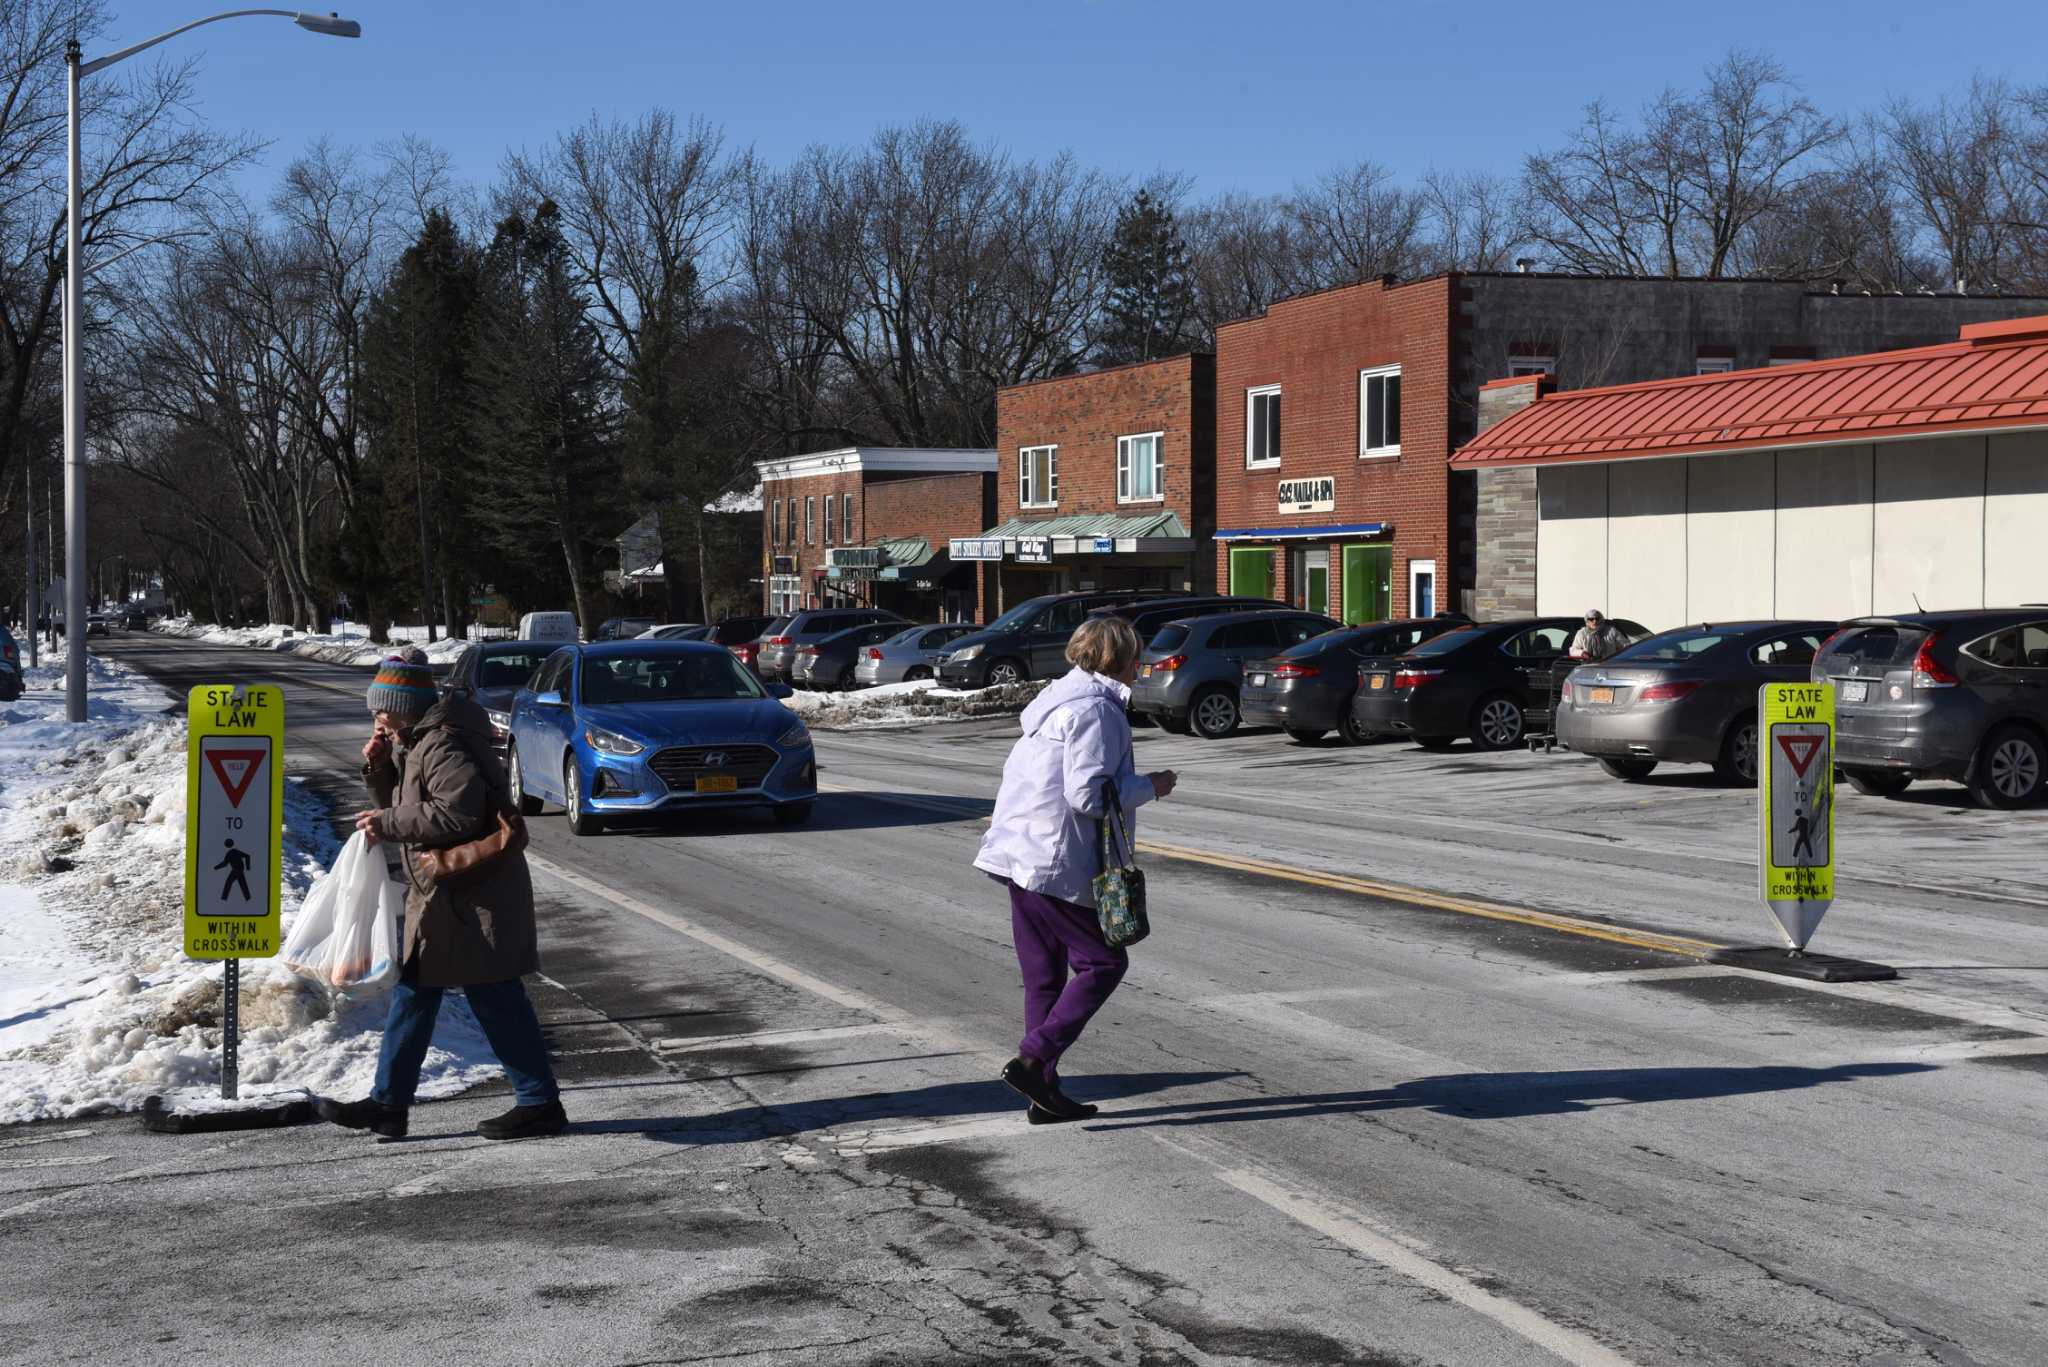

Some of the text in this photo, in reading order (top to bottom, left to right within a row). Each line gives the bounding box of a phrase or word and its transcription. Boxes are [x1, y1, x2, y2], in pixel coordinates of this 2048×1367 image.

[1293, 480, 1313, 503] NAILS
[1314, 480, 1320, 502] &
[1320, 479, 1334, 501] SPA
[206, 690, 268, 708] STATE
[1778, 689, 1823, 703] STATE
[1786, 706, 1816, 719] LAW
[215, 712, 257, 728] LAW
[1794, 791, 1808, 803] TO
[225, 817, 243, 830] TO
[1784, 871, 1816, 882] WITHIN
[1772, 884, 1828, 896] CROSSWALK
[208, 921, 257, 935] WITHIN
[193, 939, 270, 952] CROSSWALK
